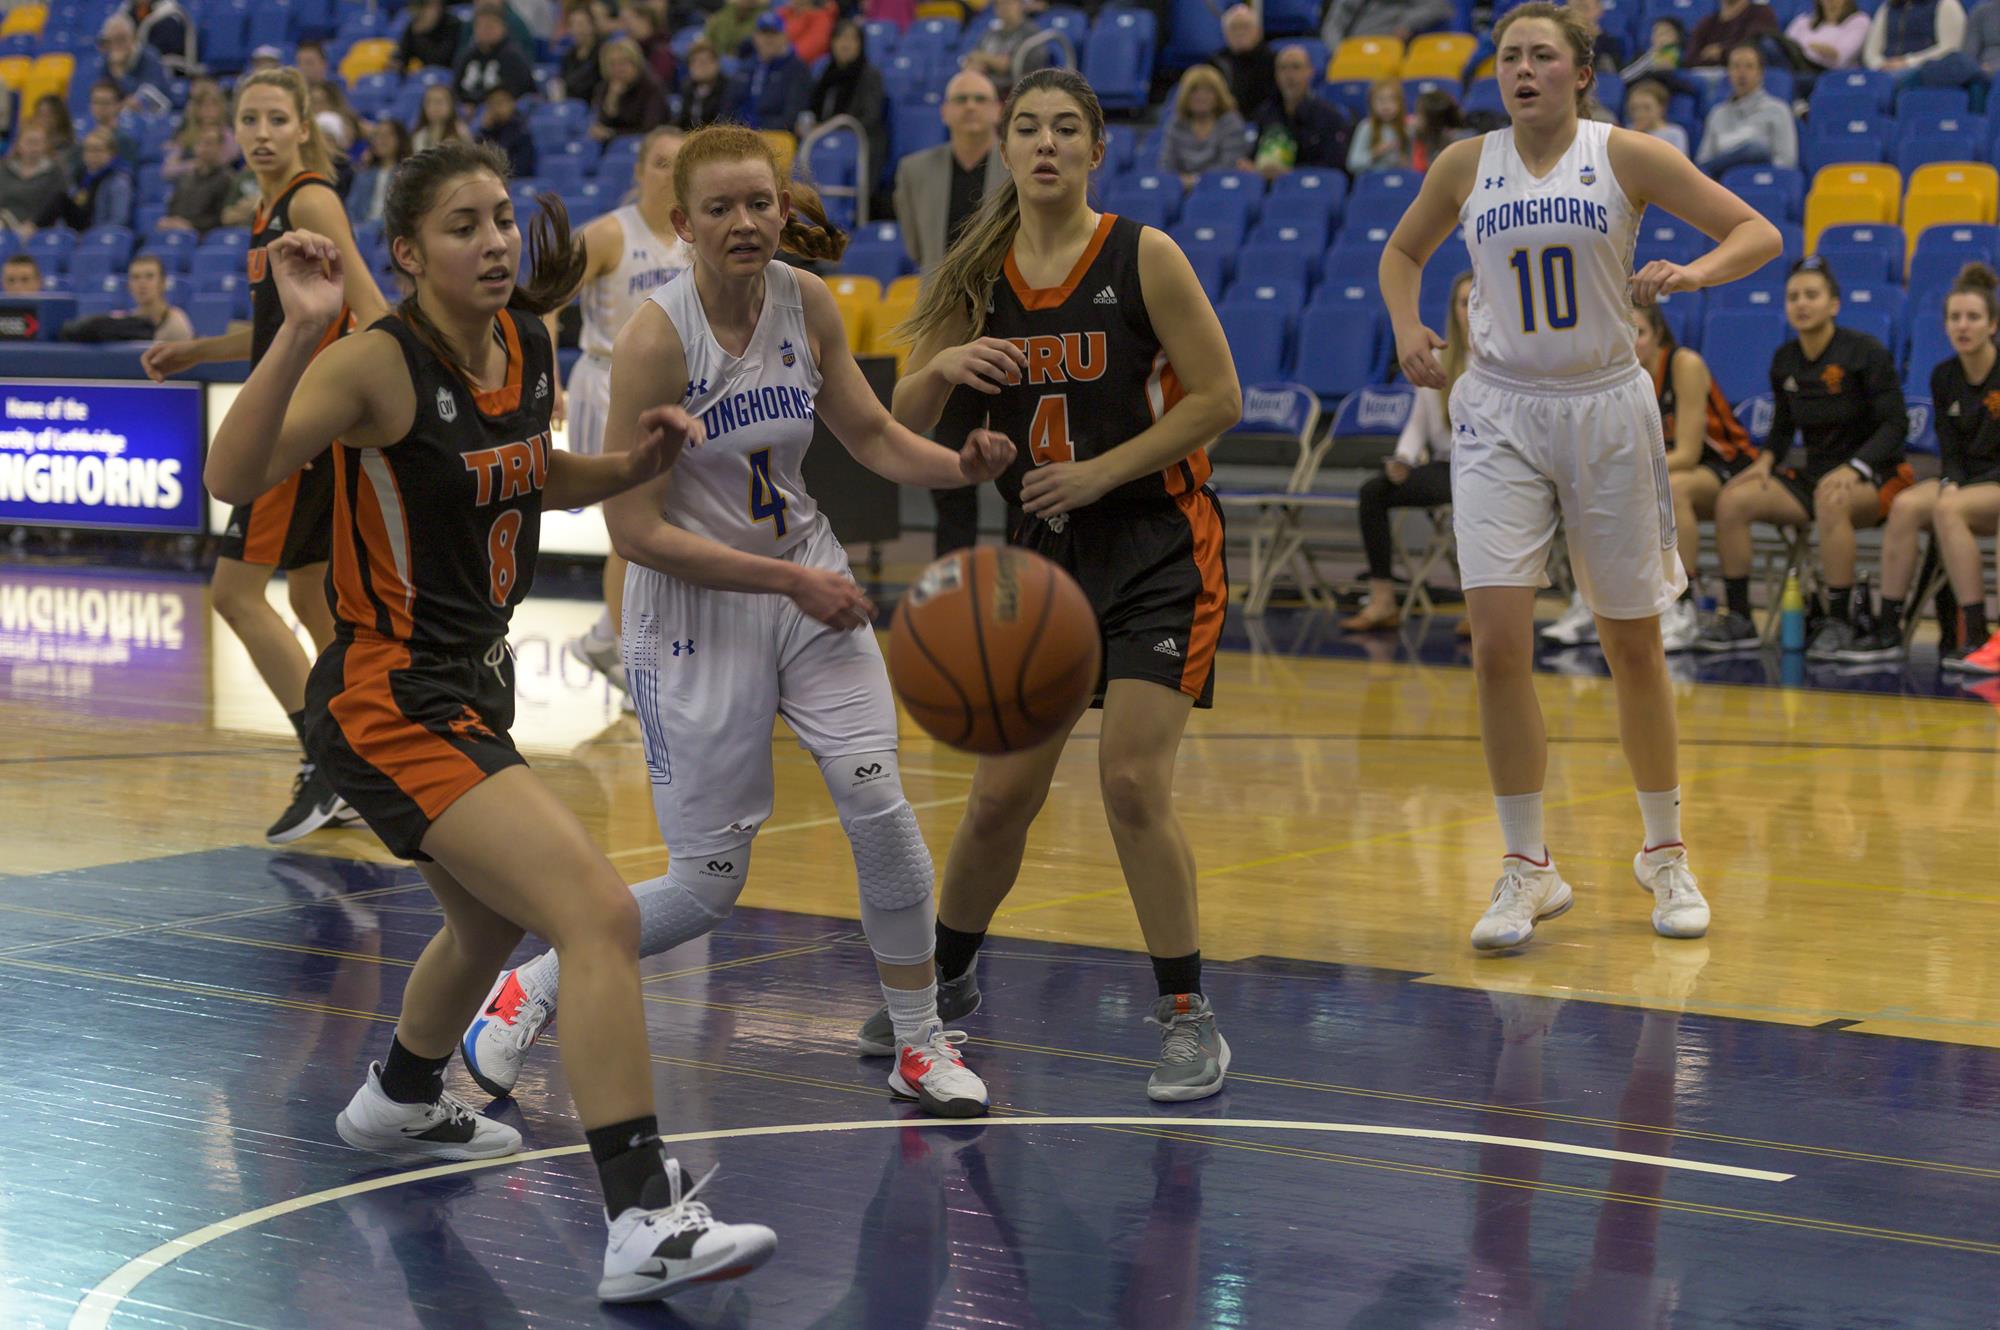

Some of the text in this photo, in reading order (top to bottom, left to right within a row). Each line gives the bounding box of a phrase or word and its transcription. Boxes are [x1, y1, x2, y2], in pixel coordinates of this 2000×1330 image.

[1476, 197, 1608, 245] PRONGHORNS
[1508, 244, 1579, 335] 10
[689, 386, 814, 448] ONGHORNS
[1029, 393, 1075, 467] 4
[460, 431, 550, 507] TRU
[749, 446, 788, 541] 4
[488, 509, 522, 607] 8
